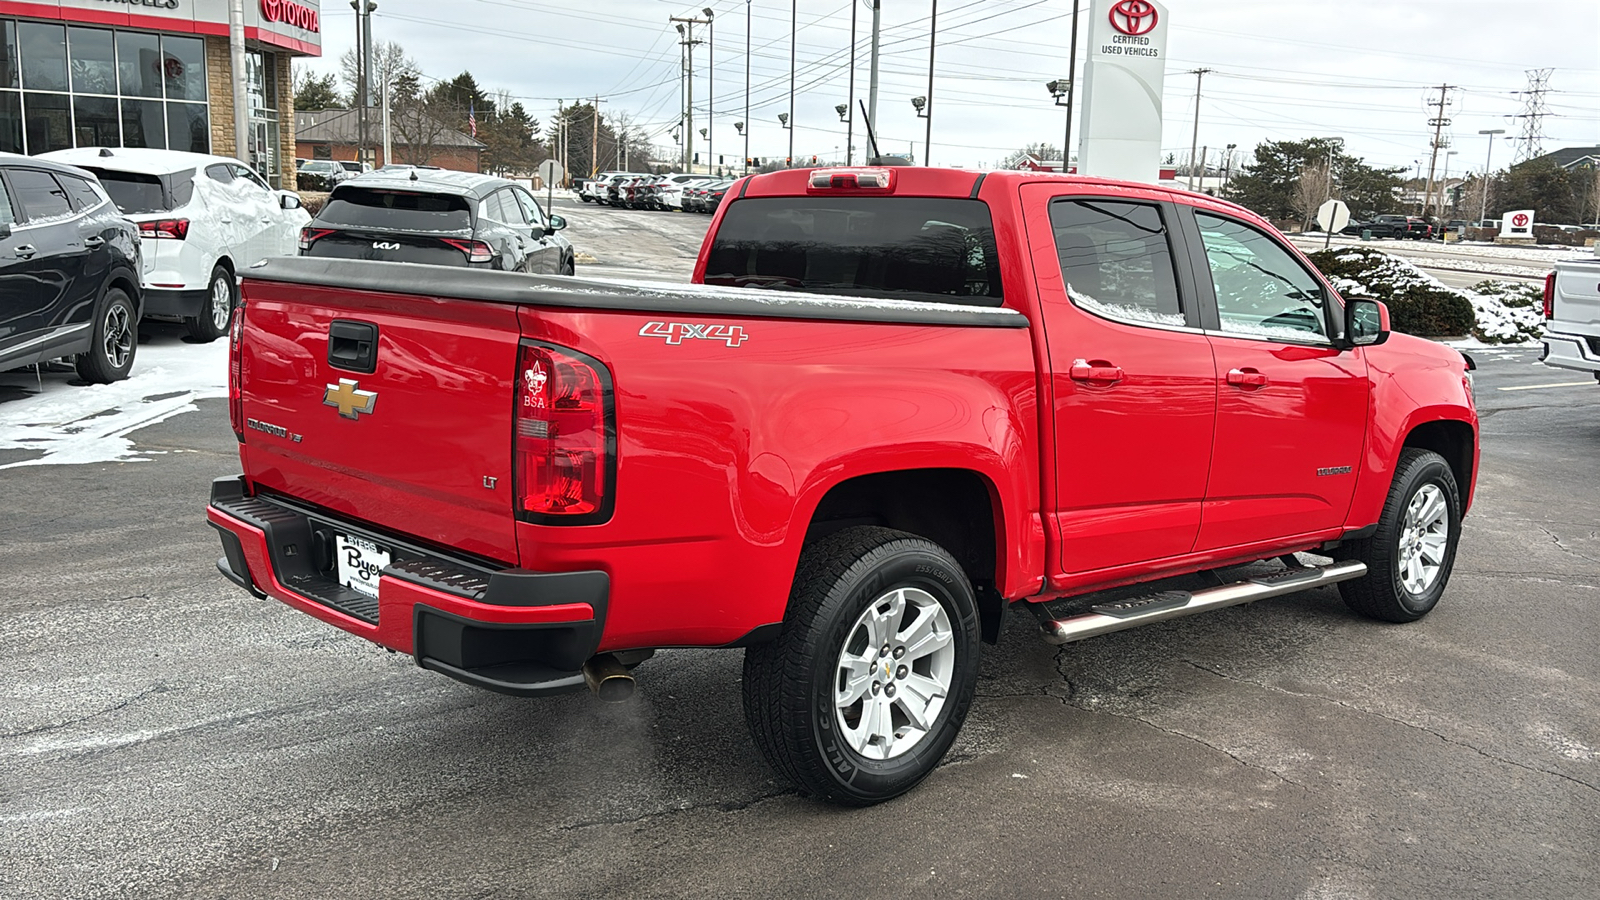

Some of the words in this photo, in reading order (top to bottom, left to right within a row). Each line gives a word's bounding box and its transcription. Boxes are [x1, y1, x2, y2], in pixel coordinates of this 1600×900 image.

[280, 1, 320, 33] TOYOTA
[1112, 35, 1149, 45] CERTIFIED
[1102, 45, 1122, 54] USED
[1124, 47, 1158, 57] VEHICLES
[523, 395, 545, 409] BSA
[247, 417, 288, 438] COLORADO
[483, 475, 498, 490] LT
[341, 545, 383, 581] Byer
[915, 564, 954, 584] 255/65R17
[827, 740, 852, 775] ALL
